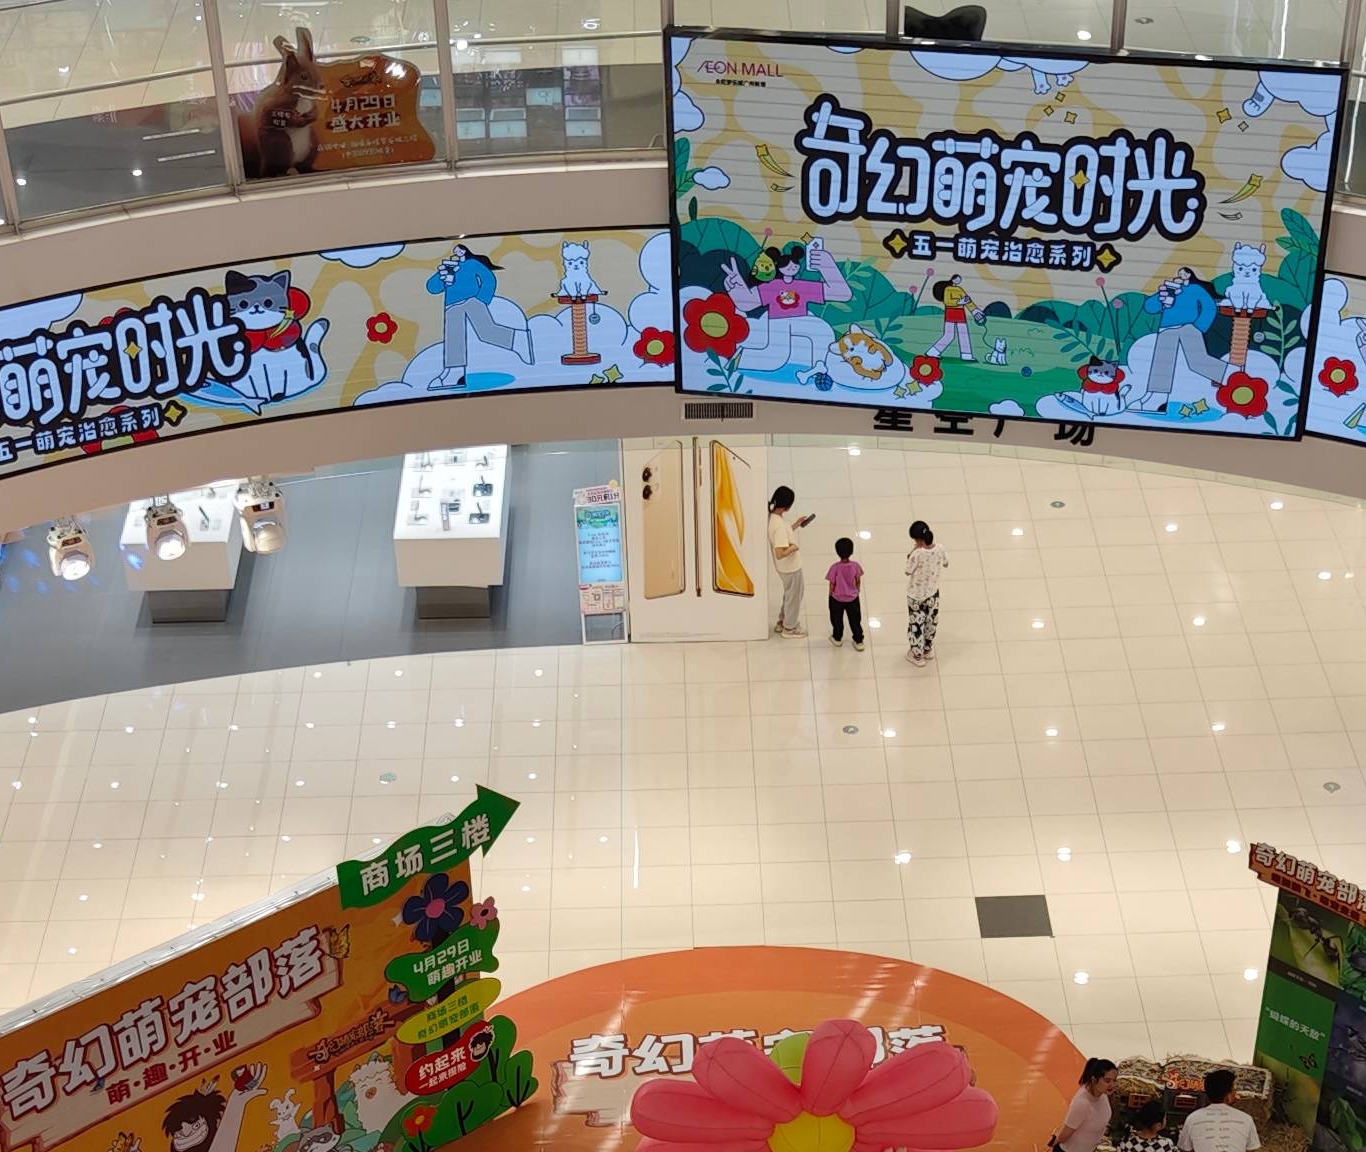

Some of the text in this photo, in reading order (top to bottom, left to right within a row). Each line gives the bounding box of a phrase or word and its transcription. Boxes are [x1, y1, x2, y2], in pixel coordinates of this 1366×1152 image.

[741, 62, 784, 77] MALL
[329, 93, 397, 113] 4月29日
[330, 110, 402, 133] 盛大开业
[802, 100, 1198, 236] 奇幻萌宠时光
[911, 235, 1093, 268] 五一萌宠治愈系列
[359, 813, 491, 896] 商场三楼
[413, 938, 471, 974] 4月29日
[427, 950, 483, 986] 萌趣开业
[3, 924, 323, 1120] 奇幻萌宠部落
[418, 1046, 467, 1079] 约起来
